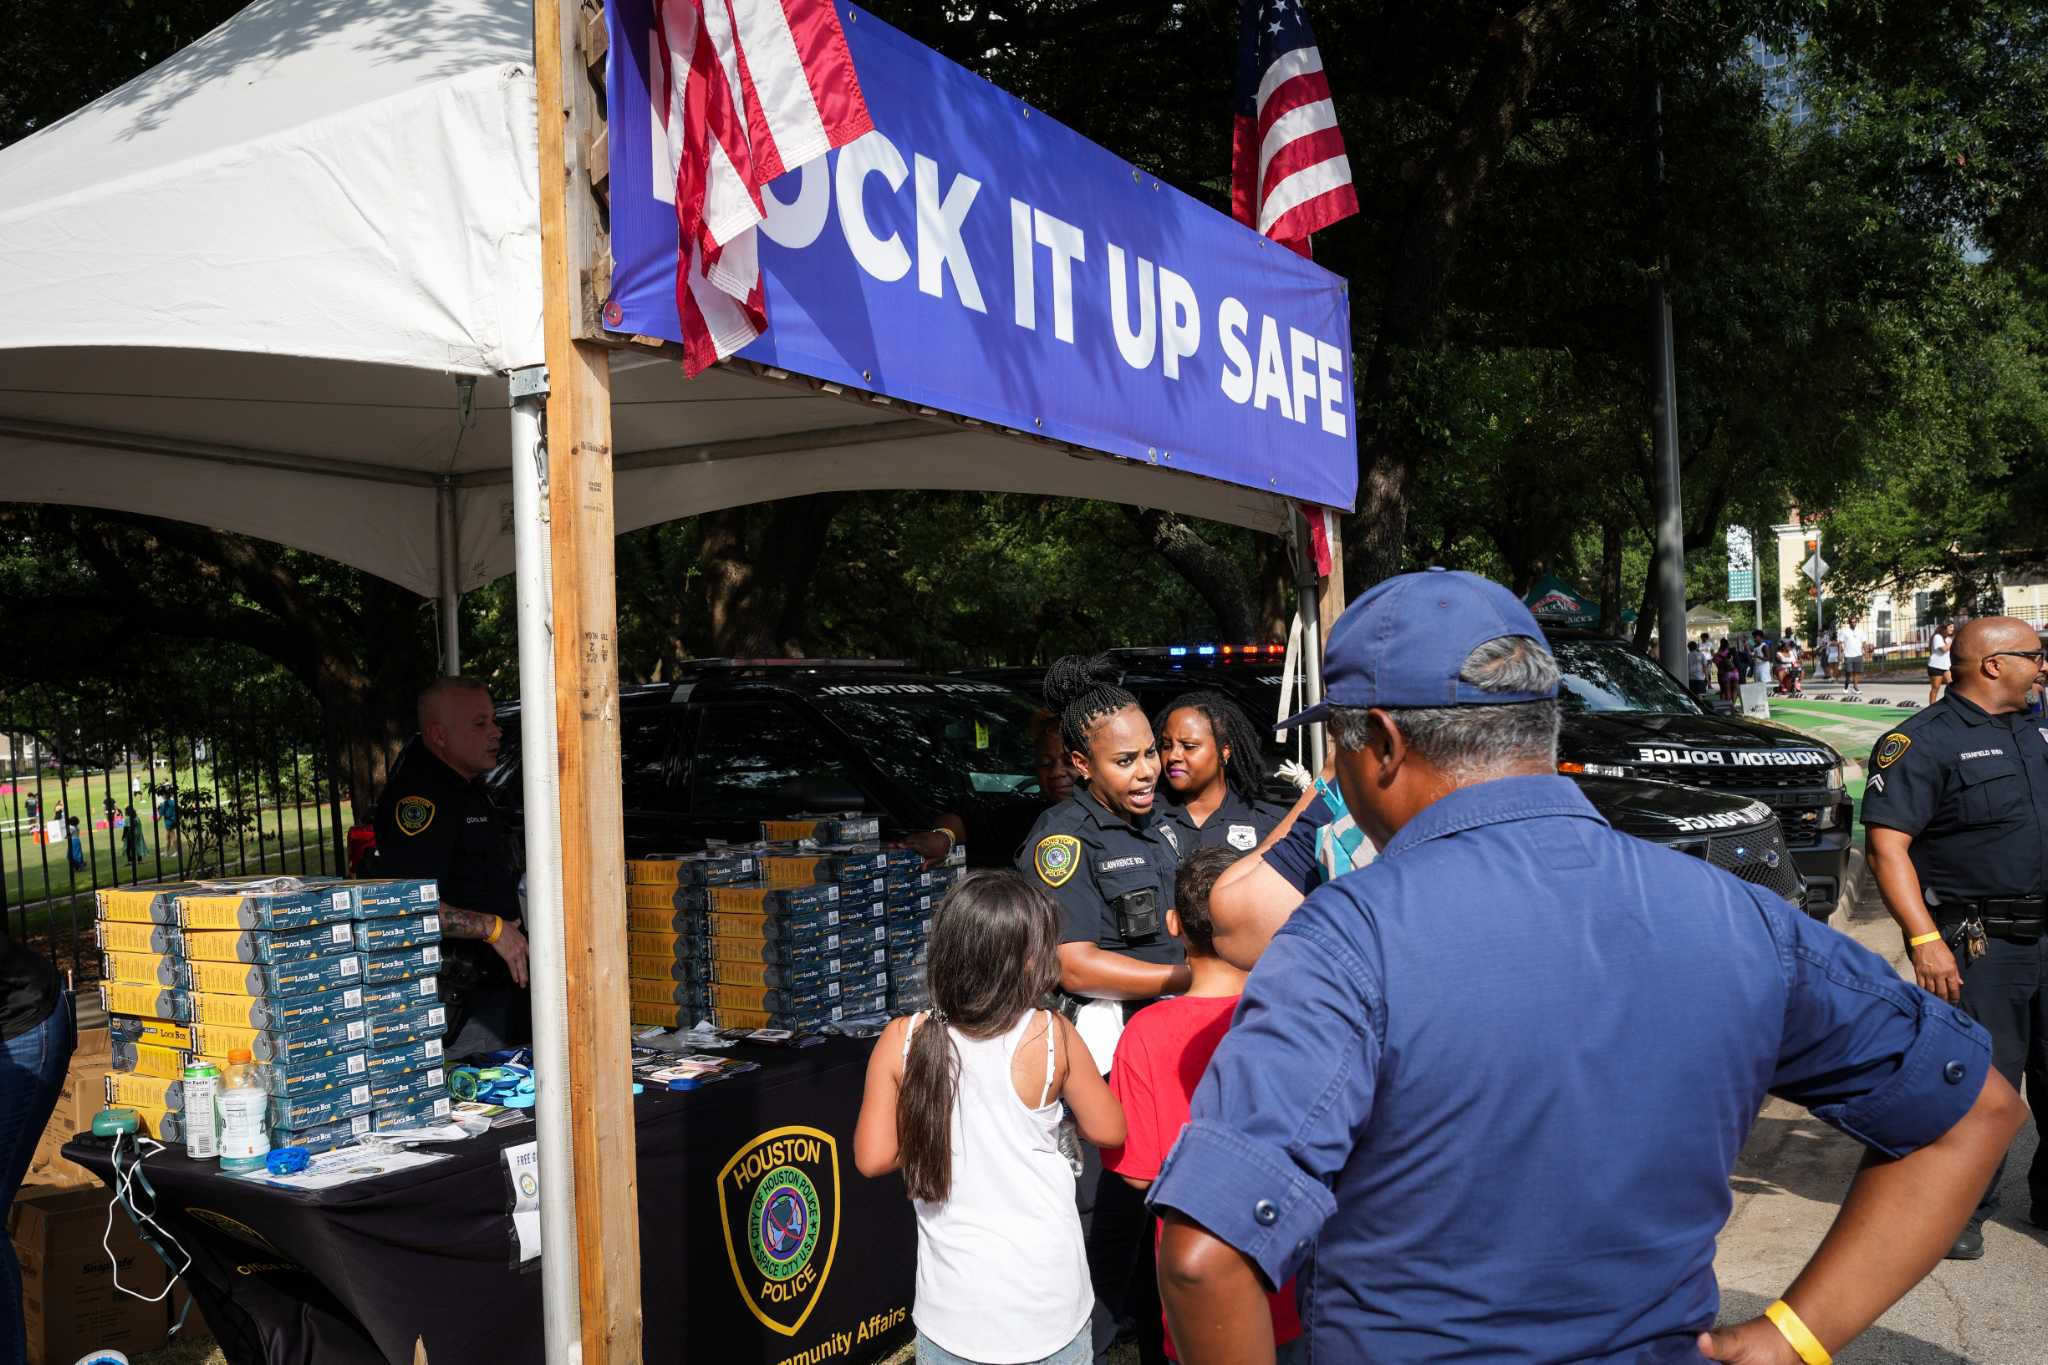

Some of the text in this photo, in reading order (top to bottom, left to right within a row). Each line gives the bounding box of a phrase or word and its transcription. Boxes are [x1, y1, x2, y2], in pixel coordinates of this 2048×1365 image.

[1009, 197, 1085, 345] IT
[1107, 241, 1201, 380] UP
[1217, 296, 1347, 438] SAFE
[821, 683, 935, 697] HOUSTON
[1102, 857, 1135, 870] LAWRENCE
[732, 1138, 822, 1191] HOUSTON
[751, 1170, 818, 1241] CITY OF HOUSTON POLICE
[757, 1252, 780, 1277] SPACE
[781, 1259, 801, 1277] CITY
[760, 1263, 817, 1304] POLICE
[857, 1305, 907, 1344] Affairs
